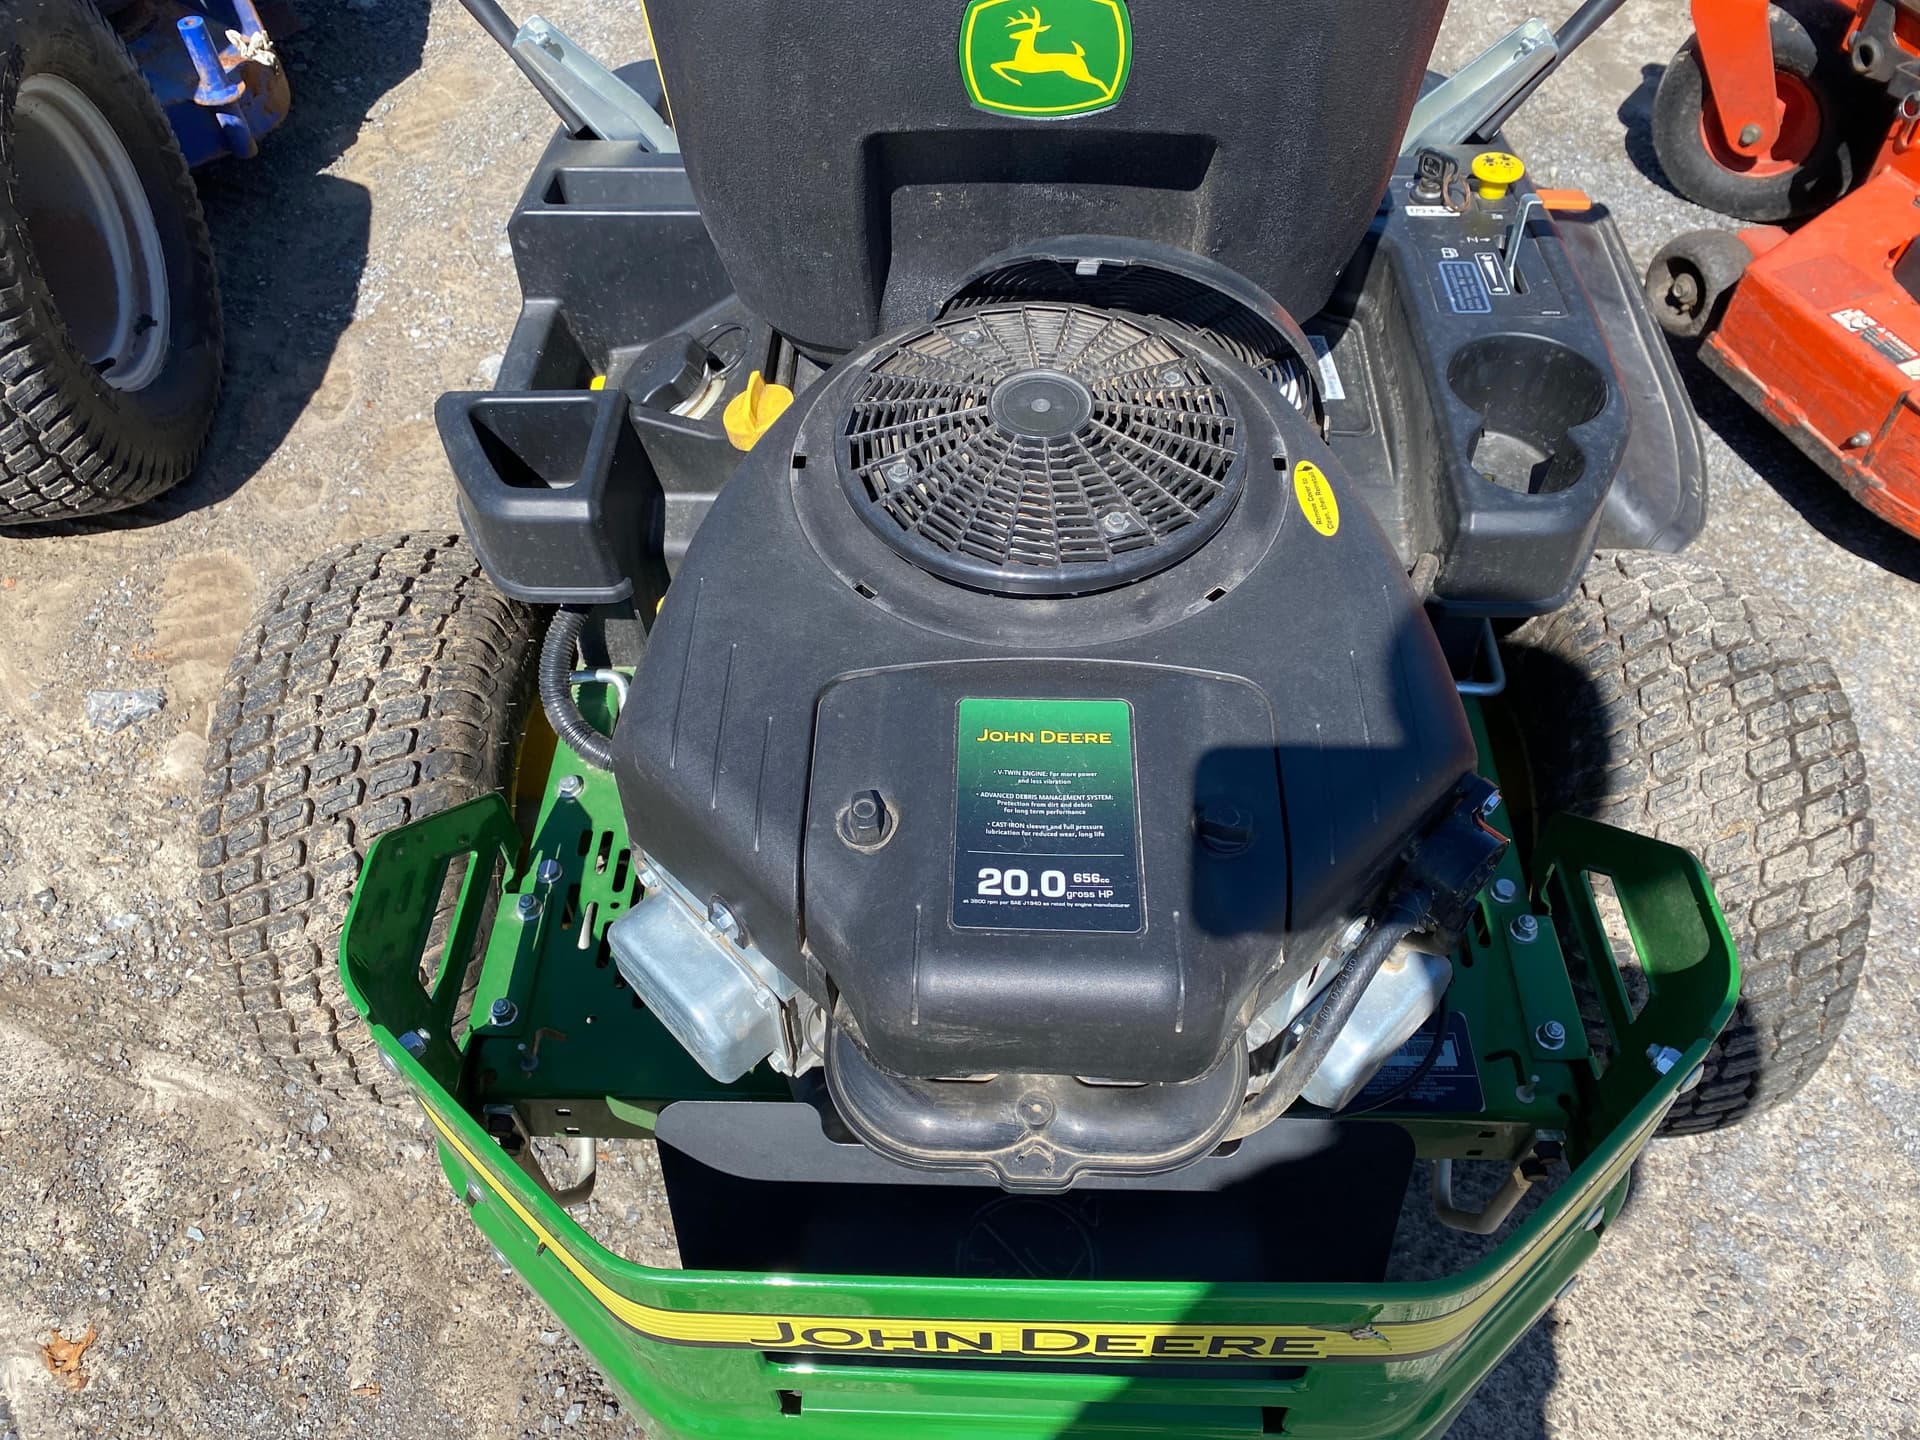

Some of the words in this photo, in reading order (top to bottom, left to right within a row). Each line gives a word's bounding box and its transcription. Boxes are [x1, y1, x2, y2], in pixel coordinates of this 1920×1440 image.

[976, 728, 1034, 743] JOHN
[1040, 730, 1112, 744] DEERE
[977, 868, 1066, 897] 20.0
[1073, 872, 1109, 883] 656cc
[1067, 890, 1095, 899] gross
[1098, 890, 1113, 898] HP
[750, 1322, 993, 1352] JOHN
[1024, 1329, 1326, 1357] DEERE
